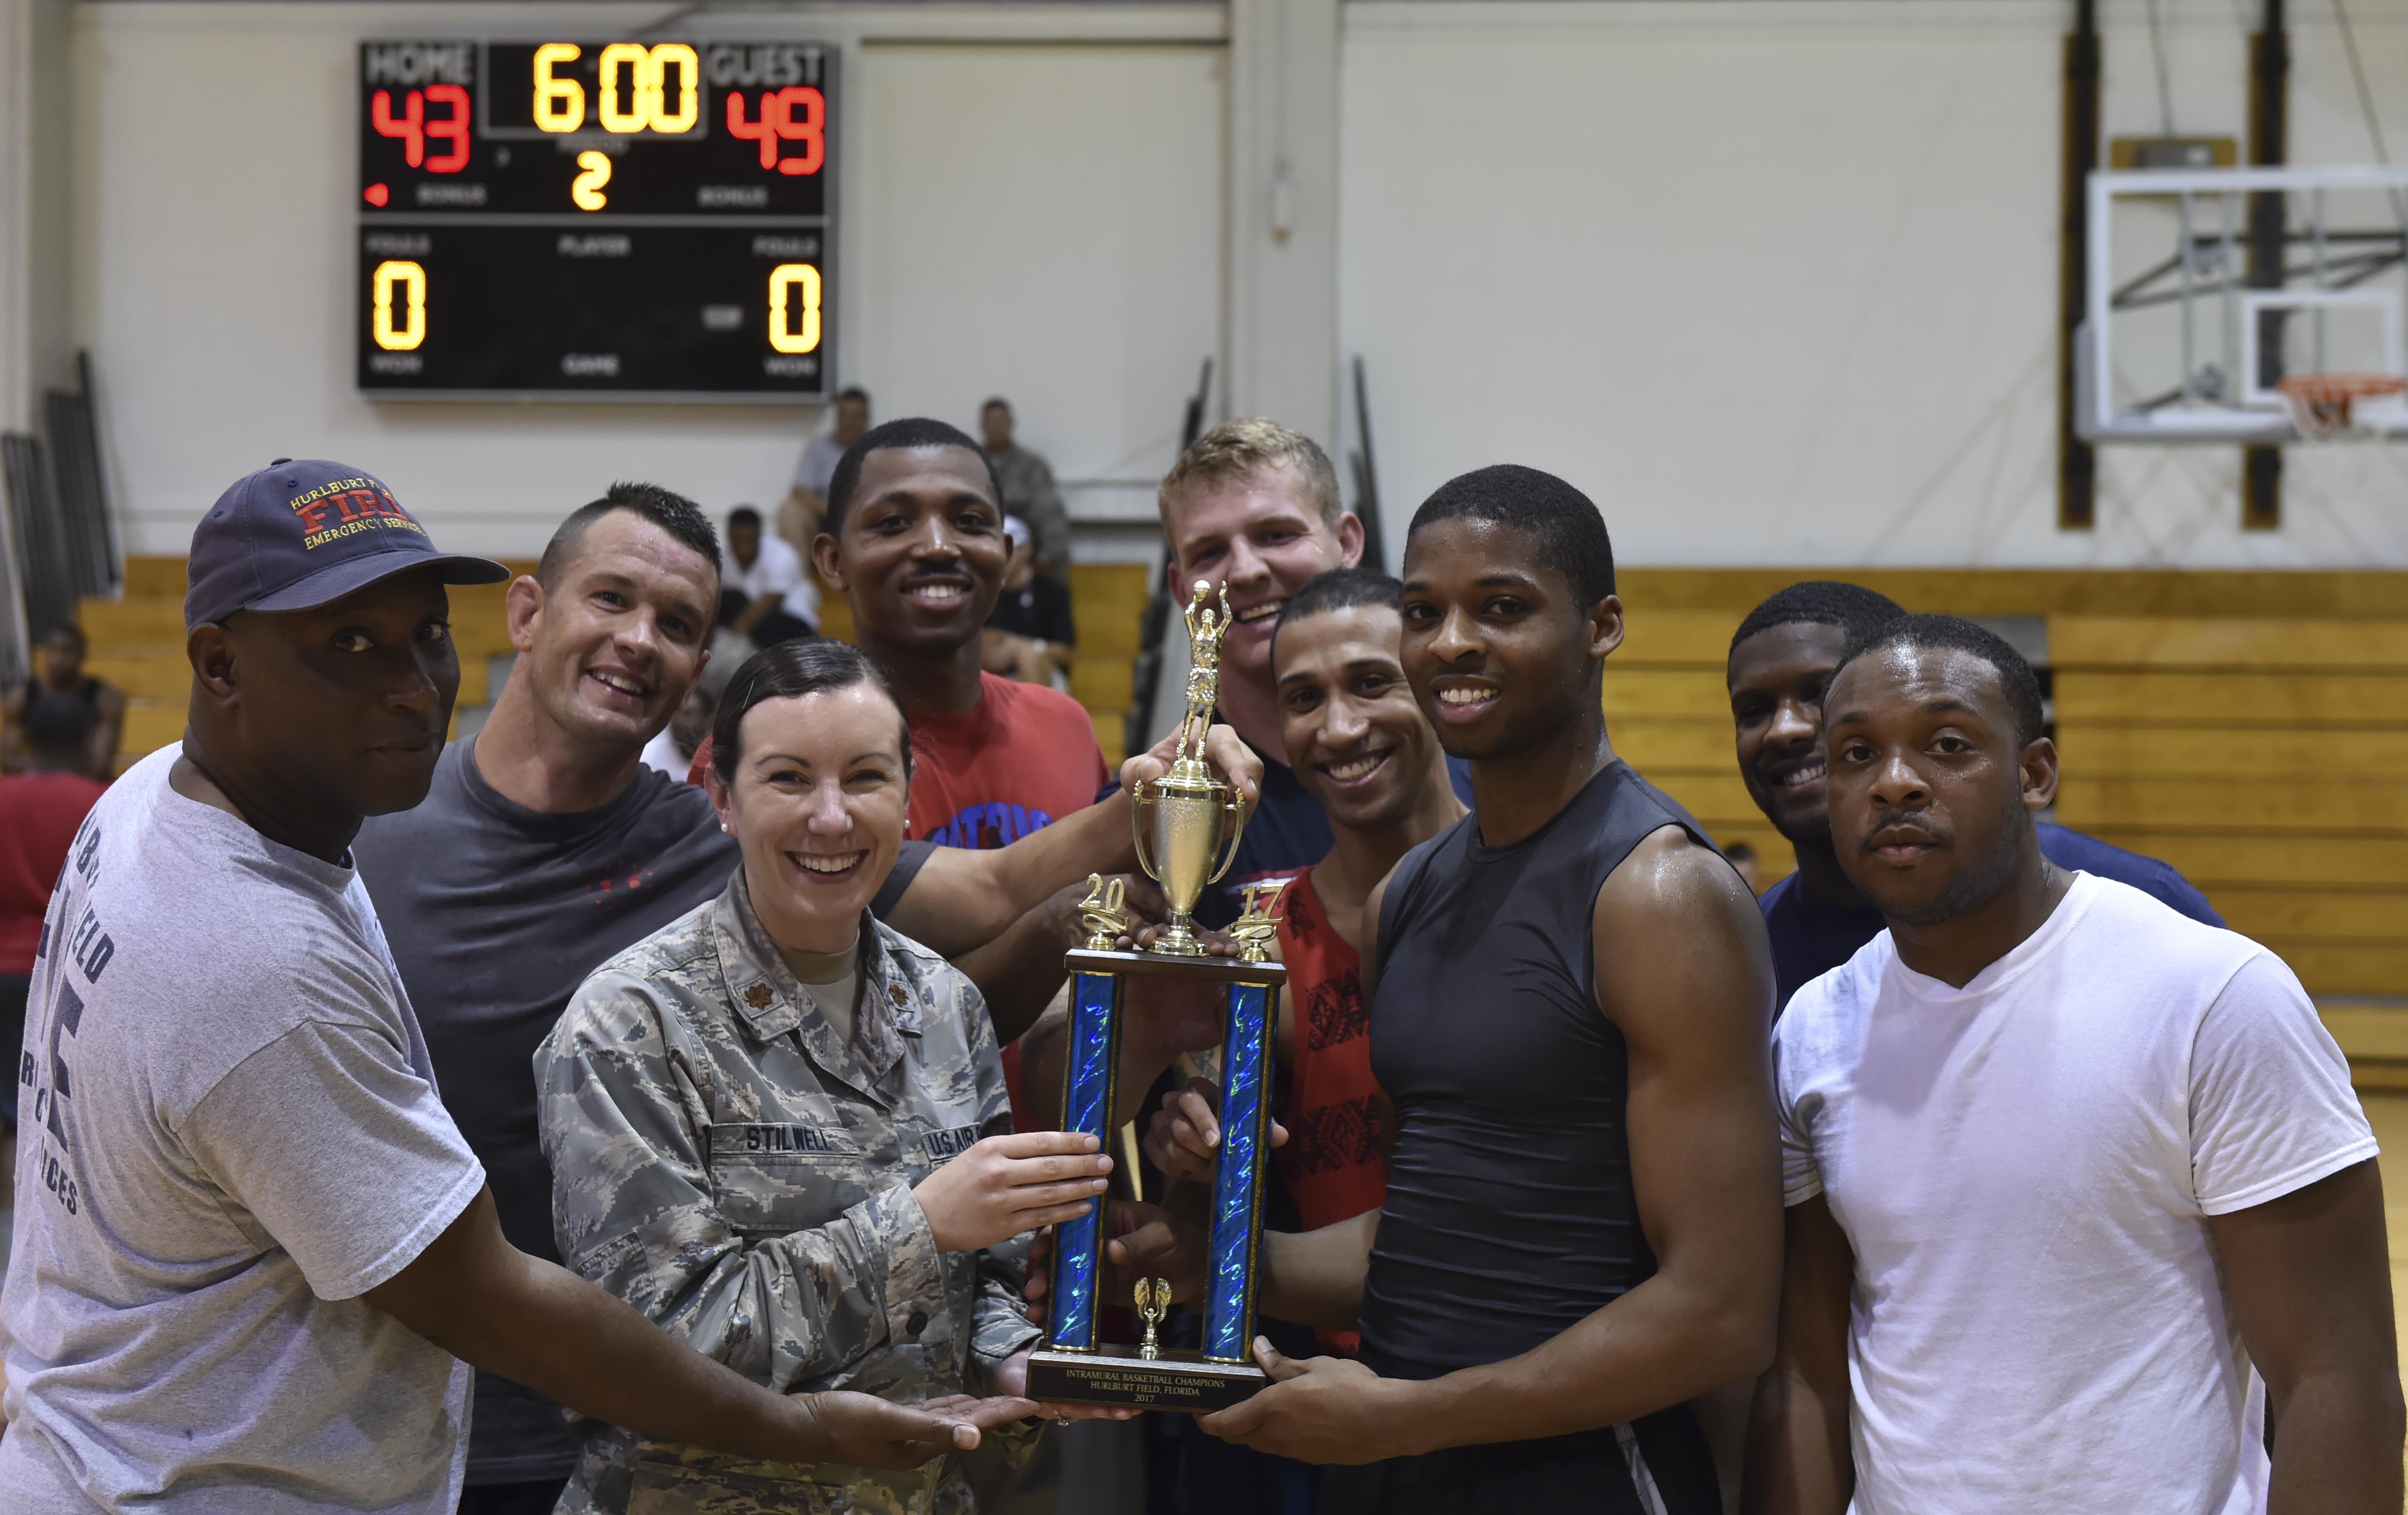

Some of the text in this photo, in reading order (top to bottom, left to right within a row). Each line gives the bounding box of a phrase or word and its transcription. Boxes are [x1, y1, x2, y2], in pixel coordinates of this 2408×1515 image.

[367, 47, 473, 84] HOME
[708, 47, 824, 84] GUEST
[372, 85, 470, 173] 43
[727, 87, 825, 175] 49
[572, 150, 612, 211] 2
[373, 261, 426, 350] 0
[768, 263, 822, 354] 0
[562, 354, 618, 375] GAME
[290, 478, 366, 510] HURLBURT
[304, 518, 382, 549] EMERGENCY
[1079, 872, 1125, 915] 20
[1239, 883, 1286, 921] 17
[746, 1124, 833, 1151] STILWELL
[955, 1127, 975, 1152] AIR
[1066, 1369, 1225, 1388] INTRAMURAL BASKETBALL CHAMPIONS
[1091, 1381, 1135, 1392] HURLBURT
[1164, 1386, 1200, 1396] FLORIDA
[1134, 1393, 1155, 1403] 2017
